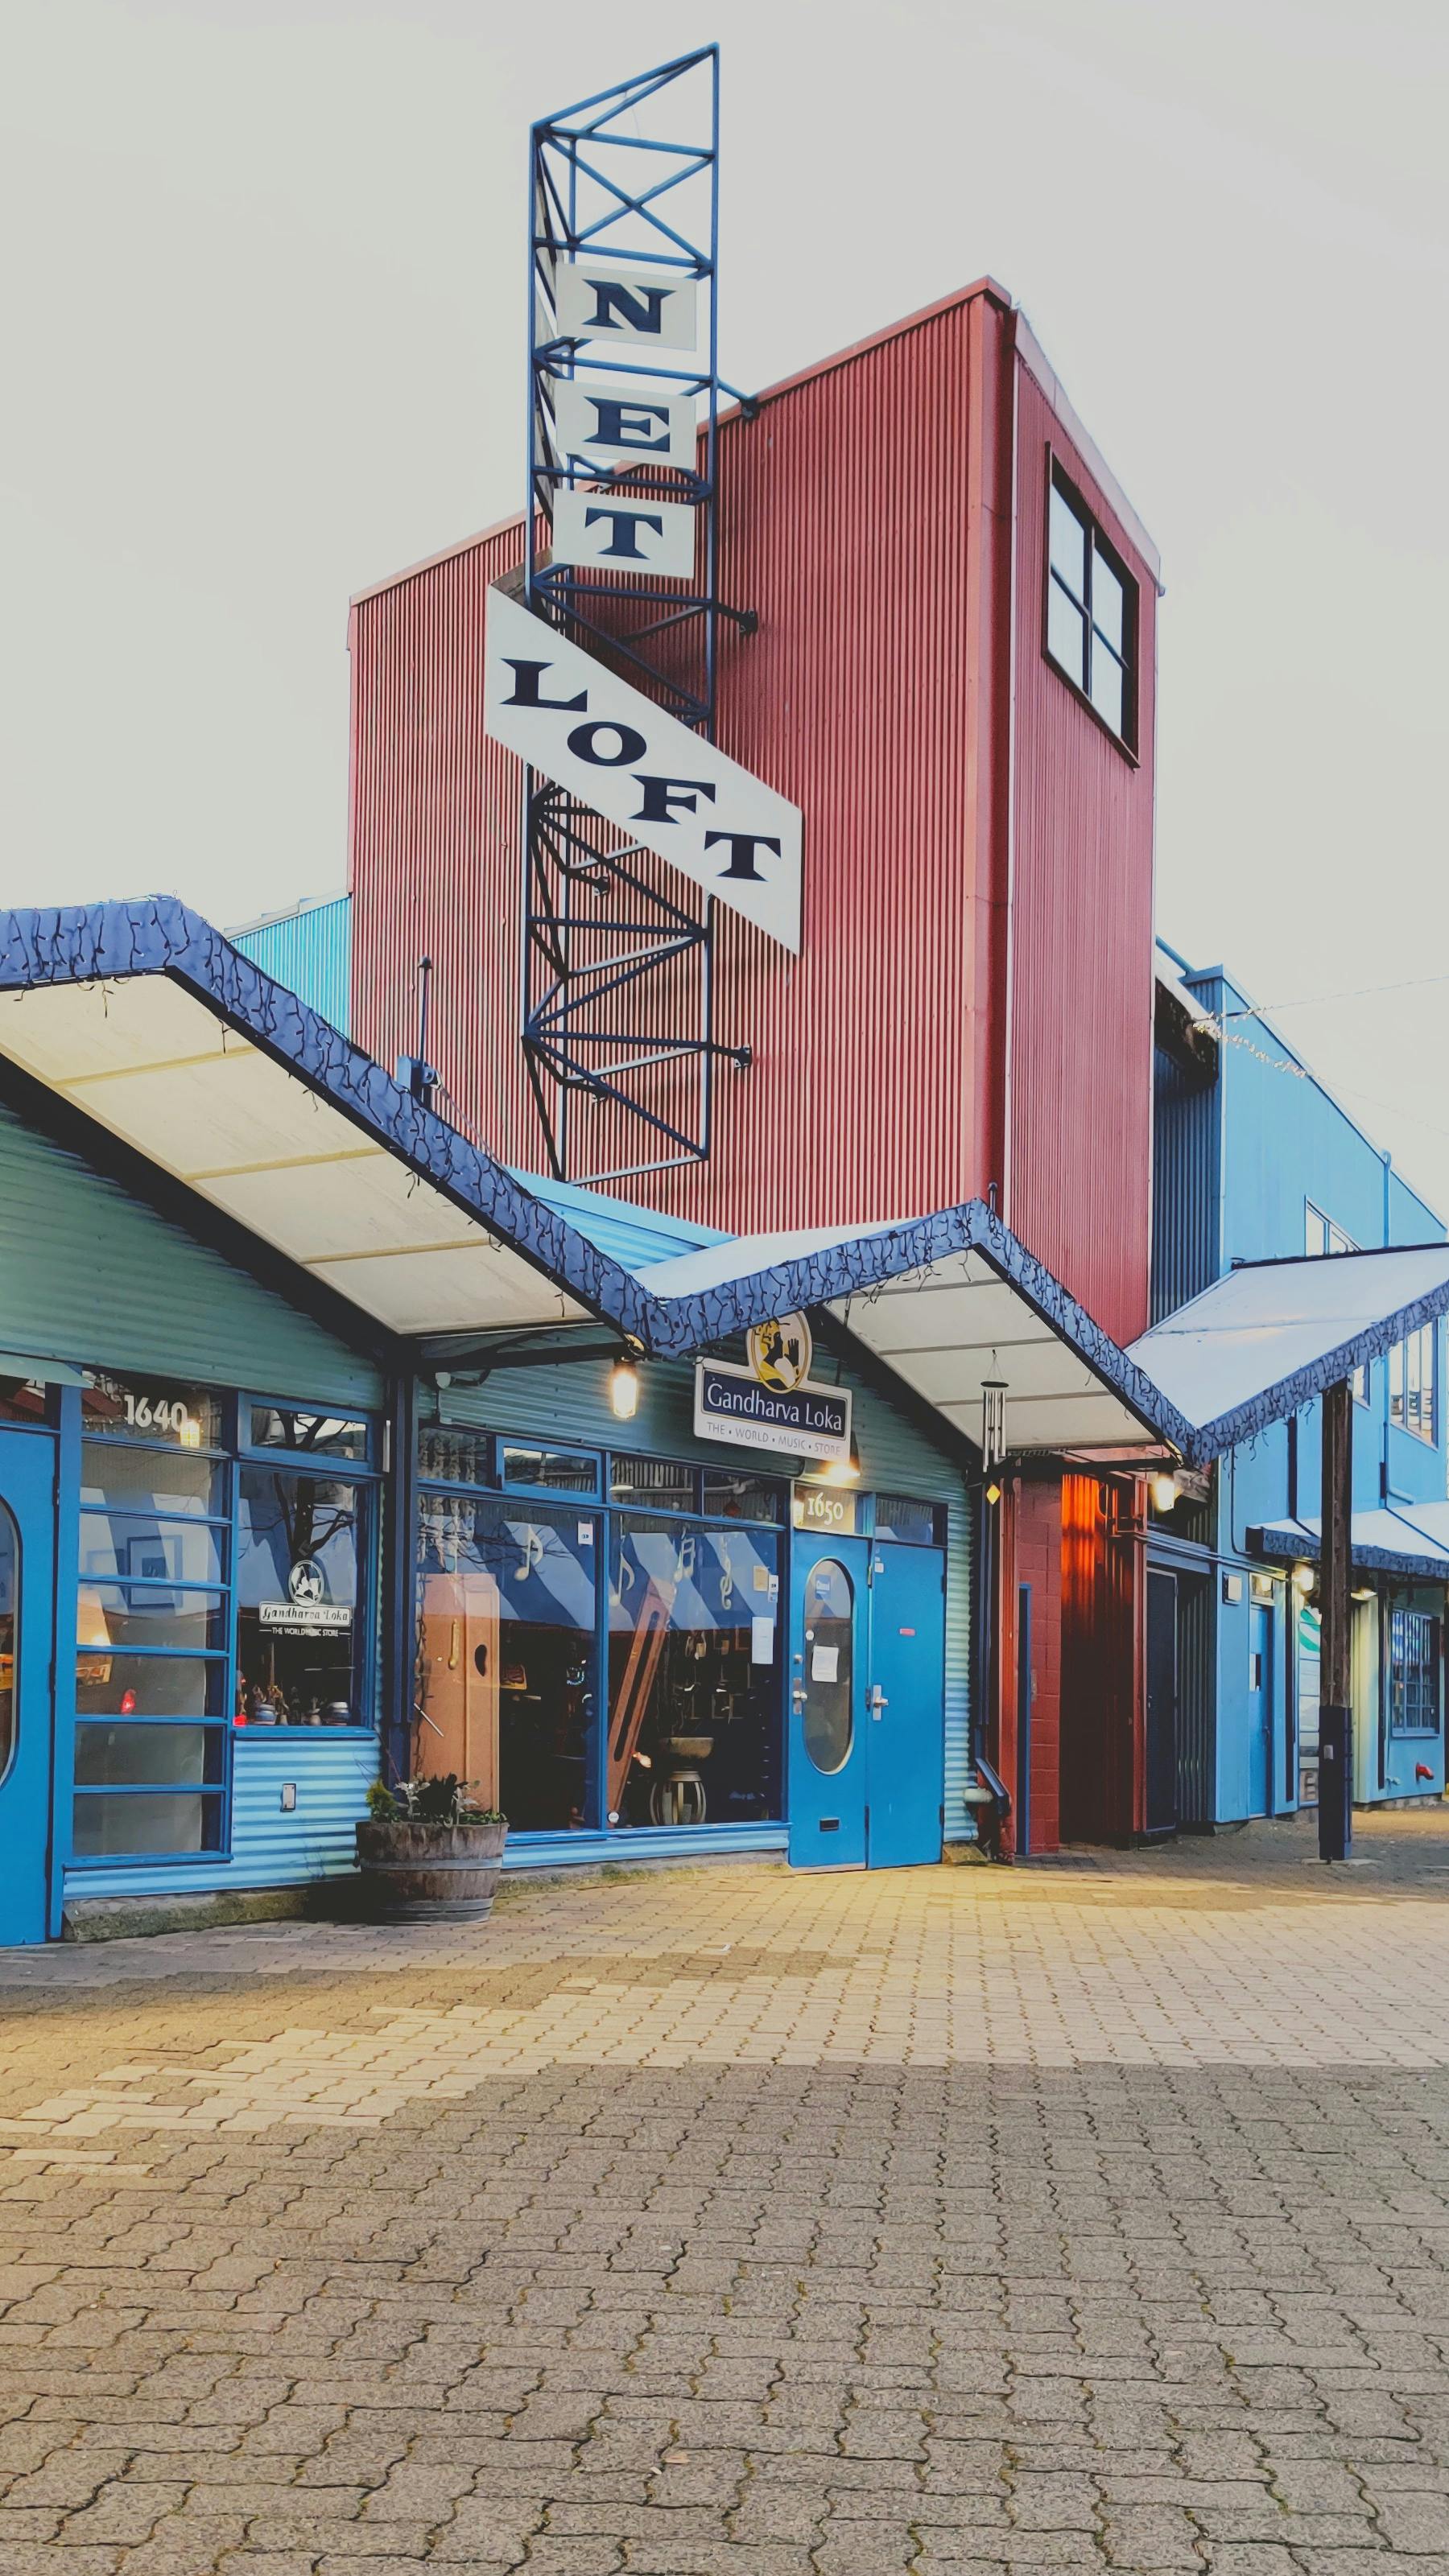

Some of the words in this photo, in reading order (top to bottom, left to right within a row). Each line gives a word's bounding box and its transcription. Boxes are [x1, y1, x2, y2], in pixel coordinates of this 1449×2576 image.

[581, 279, 676, 561] NET
[499, 657, 782, 882] LOFT
[124, 1394, 188, 1432] 1640
[707, 1383, 799, 1423] Gandharva
[806, 1403, 843, 1431] Loka
[707, 1422, 725, 1434] THE
[735, 1428, 769, 1442] WORLD
[778, 1436, 806, 1449] MUSIC
[815, 1442, 841, 1456] STORE
[807, 1491, 844, 1526] 1650
[262, 1606, 320, 1620] Gandharva
[272, 1626, 283, 1635] THE
[283, 1627, 305, 1636] WORLD
[322, 1629, 338, 1638] STORE
